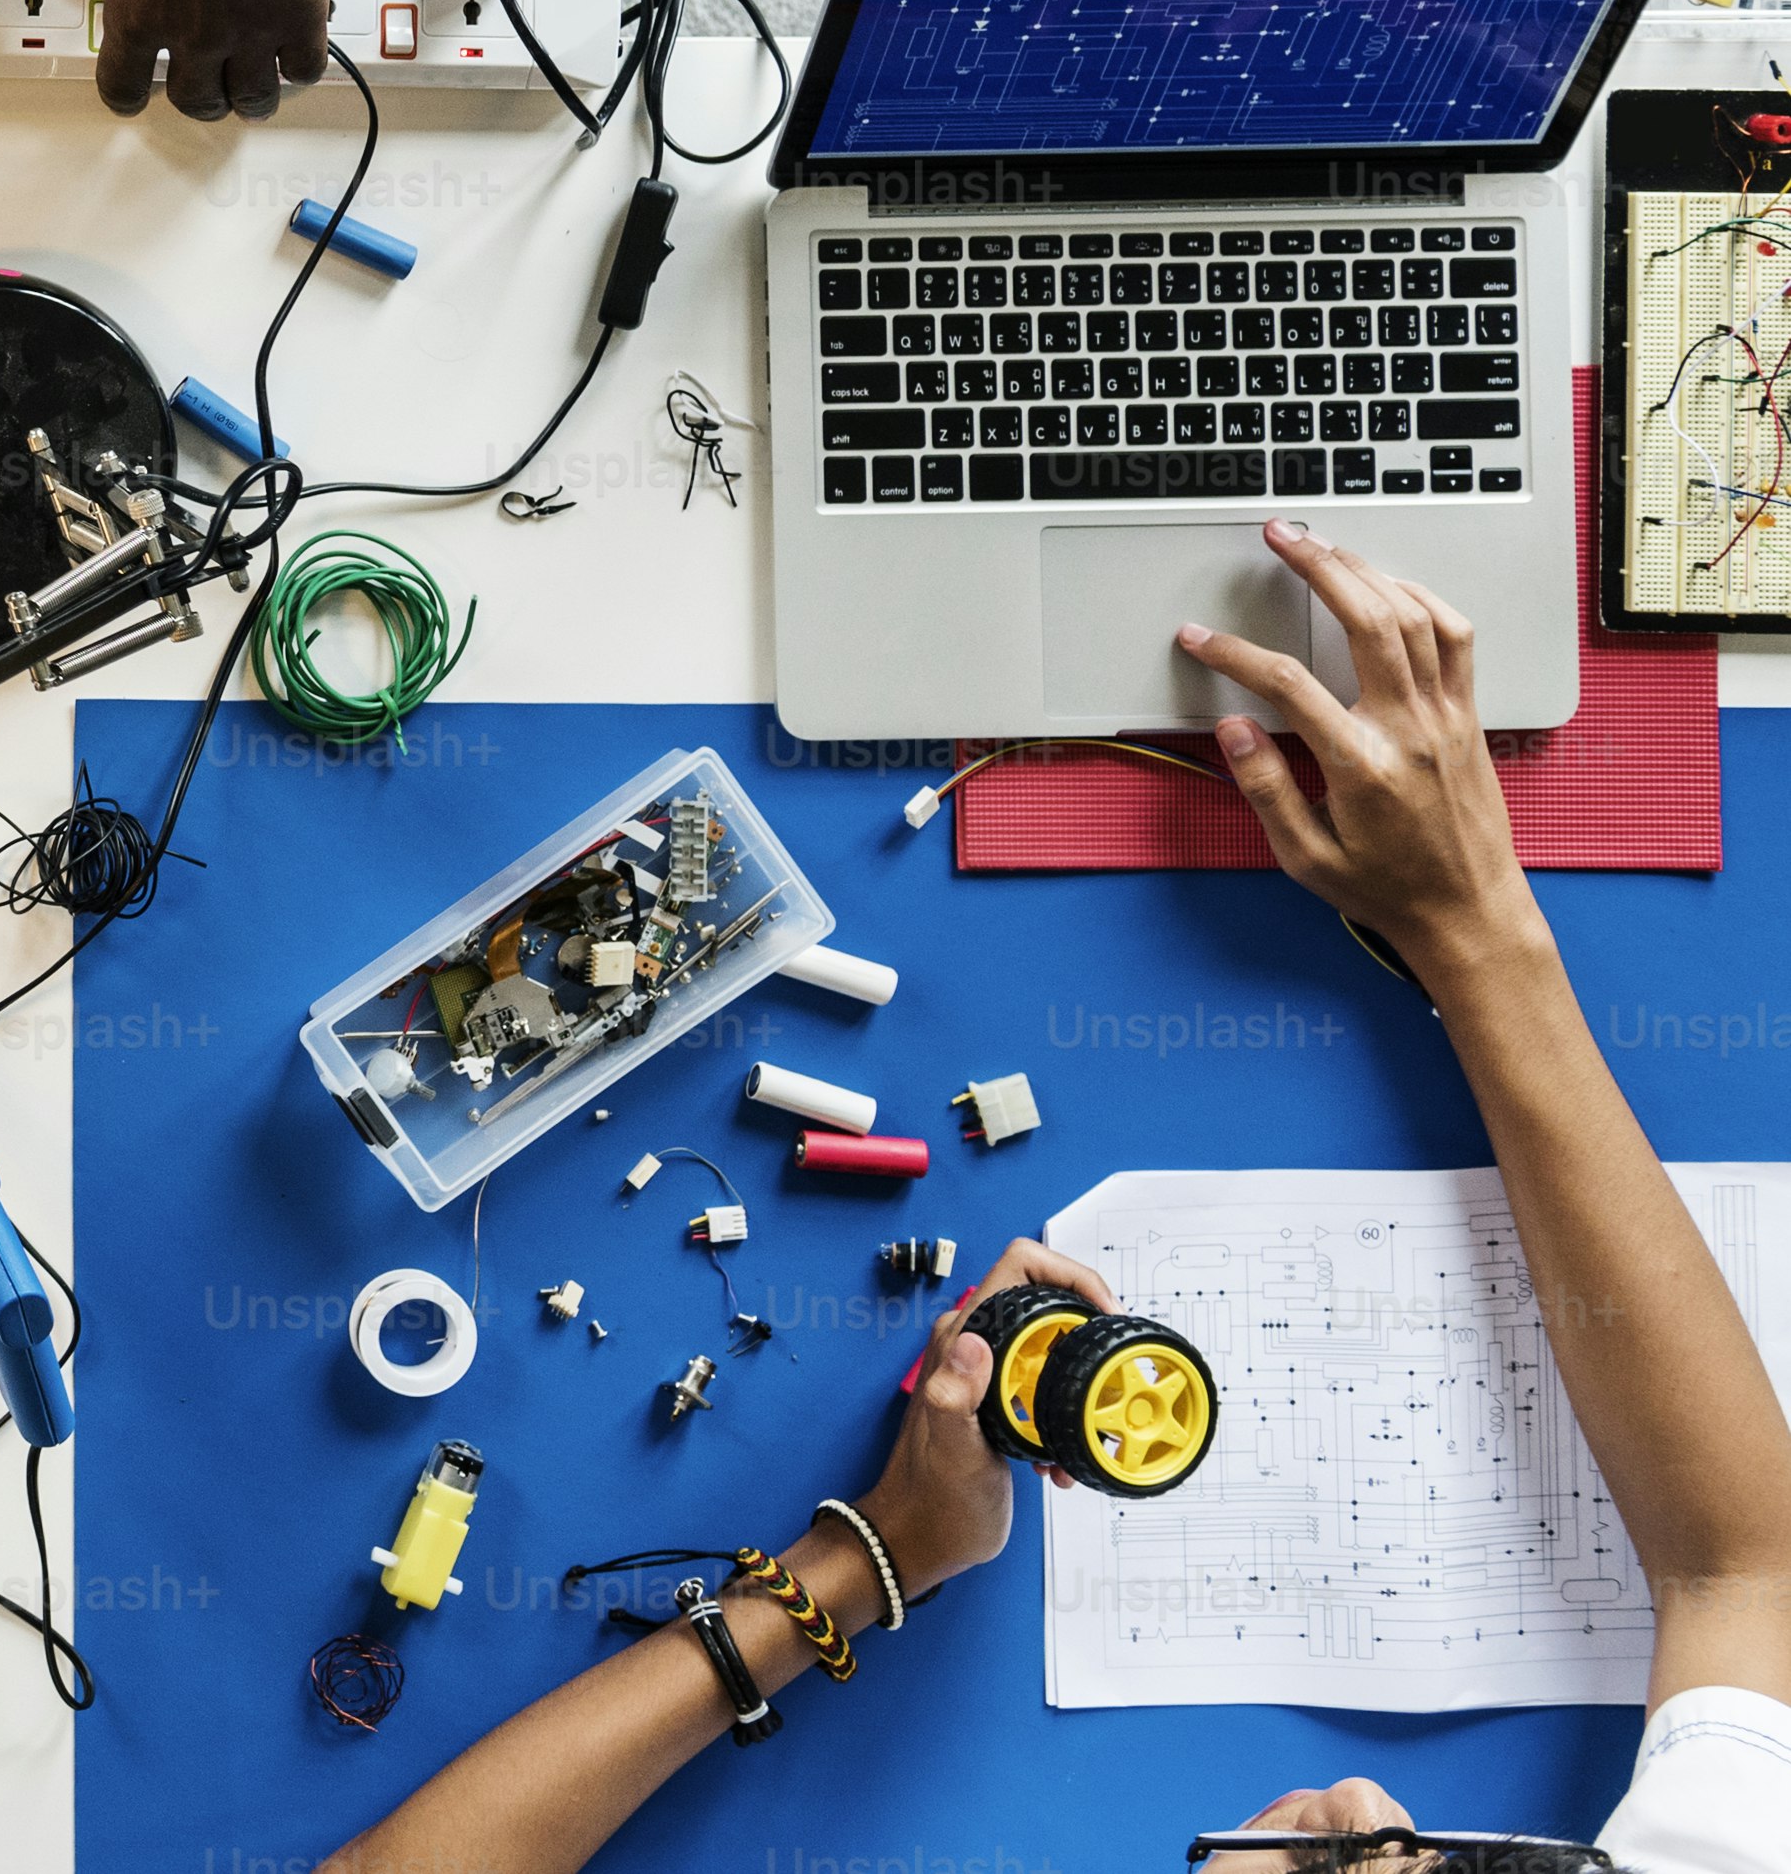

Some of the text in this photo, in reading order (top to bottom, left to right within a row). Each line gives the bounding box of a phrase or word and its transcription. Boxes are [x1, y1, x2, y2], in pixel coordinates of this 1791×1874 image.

[1021, 288, 1028, 299] 4
[1069, 287, 1075, 298] 5
[1117, 287, 1124, 297] 6
[1166, 285, 1172, 296] 7
[1214, 285, 1221, 296] 8
[1263, 284, 1269, 294] 9
[1311, 283, 1319, 294] 0
[876, 291, 879, 301] 1
[924, 290, 931, 301] 2
[973, 289, 979, 300] 3
[1046, 334, 1053, 345] R
[1095, 333, 1101, 344] T
[1143, 332, 1151, 343] Y
[1191, 331, 1200, 343] U
[1288, 329, 1298, 341] O
[1336, 328, 1344, 340] P
[901, 336, 911, 348] Q
[949, 336, 961, 347] W
[997, 335, 1003, 346] E
[1011, 381, 1019, 393] D
[1059, 380, 1065, 392] F
[1107, 379, 1117, 391] G
[1156, 379, 1165, 390] H
[1205, 378, 1210, 389] J
[1252, 377, 1260, 388] K
[1300, 376, 1307, 388] L
[853, 388, 869, 396] lock
[914, 383, 923, 394] A
[962, 382, 970, 394] S
[201, 403, 211, 412] H
[1084, 427, 1093, 438] V
[1133, 425, 1141, 437] B
[1181, 425, 1191, 436] N
[1230, 424, 1242, 435] M
[1495, 423, 1512, 431] shift
[940, 429, 947, 441] Z
[988, 429, 996, 440] X
[1036, 427, 1044, 439] C
[832, 435, 850, 444] shift
[1345, 479, 1370, 488] option
[835, 488, 843, 496] fn
[880, 487, 908, 495] control
[928, 487, 953, 496] option
[1362, 1228, 1379, 1240] 60
